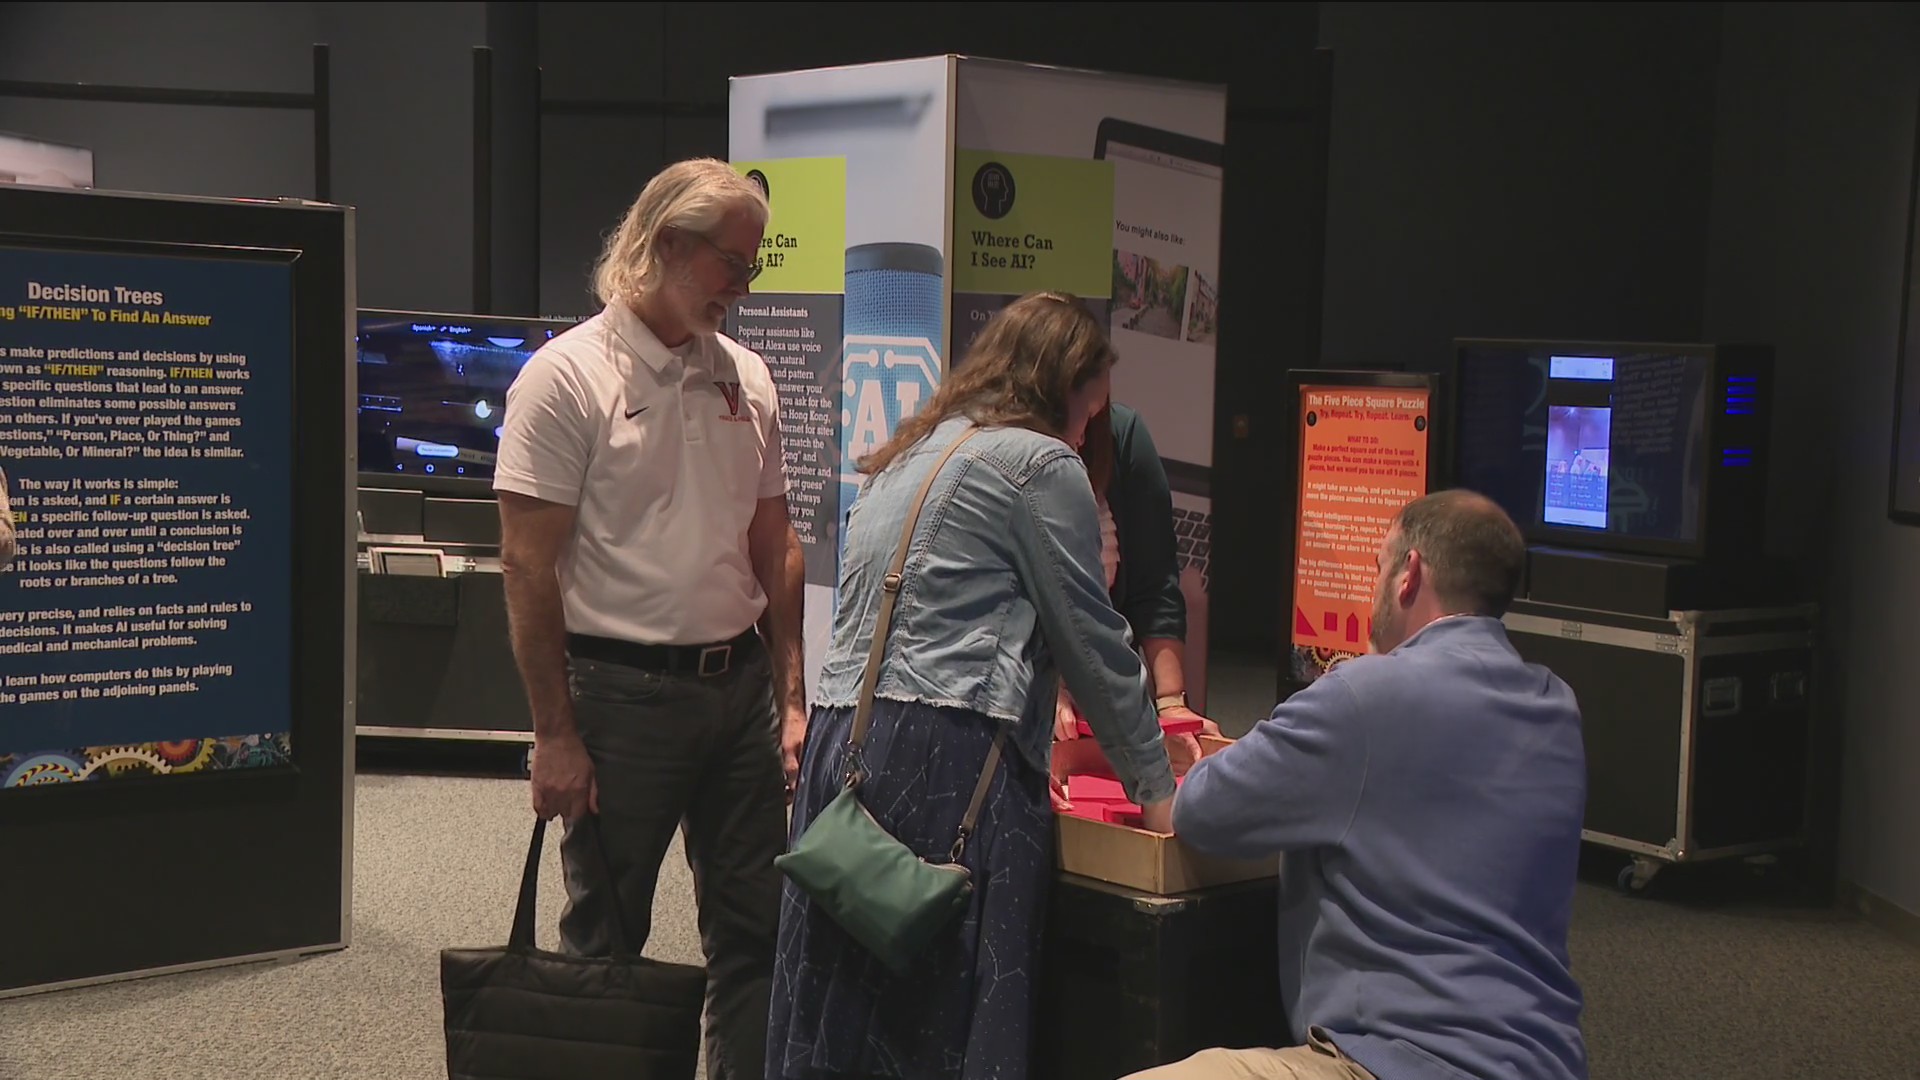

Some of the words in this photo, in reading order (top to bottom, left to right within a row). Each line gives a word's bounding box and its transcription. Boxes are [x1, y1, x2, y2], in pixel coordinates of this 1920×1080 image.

[1116, 220, 1130, 232] You
[1132, 226, 1152, 238] might
[1154, 230, 1169, 241] also
[776, 234, 797, 248] Can
[971, 231, 1019, 247] Where
[1024, 234, 1053, 249] Can
[766, 253, 784, 267] AI?
[971, 252, 977, 266] I
[982, 252, 1006, 267] See
[1010, 254, 1035, 269] AI?
[29, 283, 109, 302] Decision
[115, 287, 162, 305] Trees
[91, 309, 106, 321] To
[111, 310, 139, 322] Find
[142, 311, 159, 323] An
[163, 312, 211, 325] Answer
[739, 306, 769, 316] Personal
[771, 307, 808, 317] Assistants
[970, 310, 986, 320] On
[738, 325, 764, 338] Popular
[766, 329, 799, 337] assistants
[801, 328, 814, 338] like
[751, 339, 764, 350] and
[765, 340, 786, 350] Alexa
[788, 343, 800, 351] use
[802, 344, 821, 352] voice
[10, 348, 44, 357] make
[48, 349, 114, 360] predictions
[118, 350, 139, 360] and
[143, 351, 196, 362] decisions
[216, 353, 245, 366] using
[780, 356, 805, 365] natural
[107, 368, 167, 379] reasoning.
[170, 367, 213, 378] IF/THEN
[216, 369, 249, 379] works
[788, 370, 814, 380] pattern
[2, 380, 51, 391] specific
[55, 382, 112, 392] questions
[116, 382, 139, 392] that
[142, 383, 166, 393] lead
[201, 386, 243, 394] answer.
[779, 384, 804, 392] answer
[806, 386, 823, 395] your
[39, 397, 101, 408] eliminates
[105, 400, 136, 408] some
[139, 399, 186, 410] possible
[189, 402, 235, 410] answers
[713, 381, 740, 416] V
[795, 396, 807, 406] ask
[820, 397, 832, 408] the
[1309, 395, 1322, 405] The
[1324, 395, 1340, 406] Five
[1342, 396, 1363, 407] Piece
[1366, 397, 1394, 409] Square
[1397, 398, 1424, 409] Puzzle
[16, 413, 58, 424] others.
[115, 416, 140, 425] ever
[144, 415, 180, 427] played
[184, 415, 202, 425] the
[205, 418, 241, 427] games
[789, 409, 808, 423] Hong
[110, 430, 144, 441] Place,
[209, 432, 229, 441] and
[817, 425, 834, 436] sites
[813, 438, 824, 449] the
[143, 447, 161, 457] the
[164, 447, 188, 457] idea
[204, 447, 243, 457] similar.
[803, 451, 816, 462] and
[818, 467, 831, 477] and
[19, 479, 41, 489] The
[44, 481, 69, 491] way
[85, 479, 120, 489] works
[137, 479, 178, 490] simple:
[43, 495, 82, 505] asked,
[85, 495, 107, 505] and
[110, 494, 121, 505] IF
[135, 494, 174, 504] certain
[177, 496, 218, 504] answer
[796, 490, 820, 502] always
[42, 511, 89, 523] specific
[92, 511, 147, 521] follow-up
[151, 510, 198, 522] question
[215, 509, 250, 519] asked.
[801, 508, 814, 518] you
[48, 530, 73, 538] over
[103, 529, 128, 537] over
[131, 526, 156, 536] until
[170, 525, 229, 535] conclusion
[45, 544, 70, 554] also
[74, 543, 109, 553] called
[113, 544, 144, 554] using
[30, 560, 62, 571] looks
[65, 559, 87, 570] like
[112, 558, 167, 568] questions
[171, 557, 205, 567] follow
[20, 577, 51, 587] roots
[71, 576, 124, 586] branches
[153, 573, 177, 583] tree.
[28, 609, 75, 621] precise,
[104, 606, 135, 617] relies
[156, 604, 184, 614] facts
[211, 603, 237, 612] rules
[75, 623, 113, 634] makes
[116, 621, 127, 632] AI
[131, 620, 165, 631] useful
[188, 618, 226, 629] solving
[72, 638, 138, 650] mechanical
[142, 636, 197, 647] problems.
[6, 676, 37, 686] learn
[70, 671, 131, 682] computers
[152, 667, 173, 677] this
[193, 665, 232, 677] playing
[19, 691, 59, 703] games
[103, 685, 155, 697] adjoining
[159, 682, 199, 694] panels.
